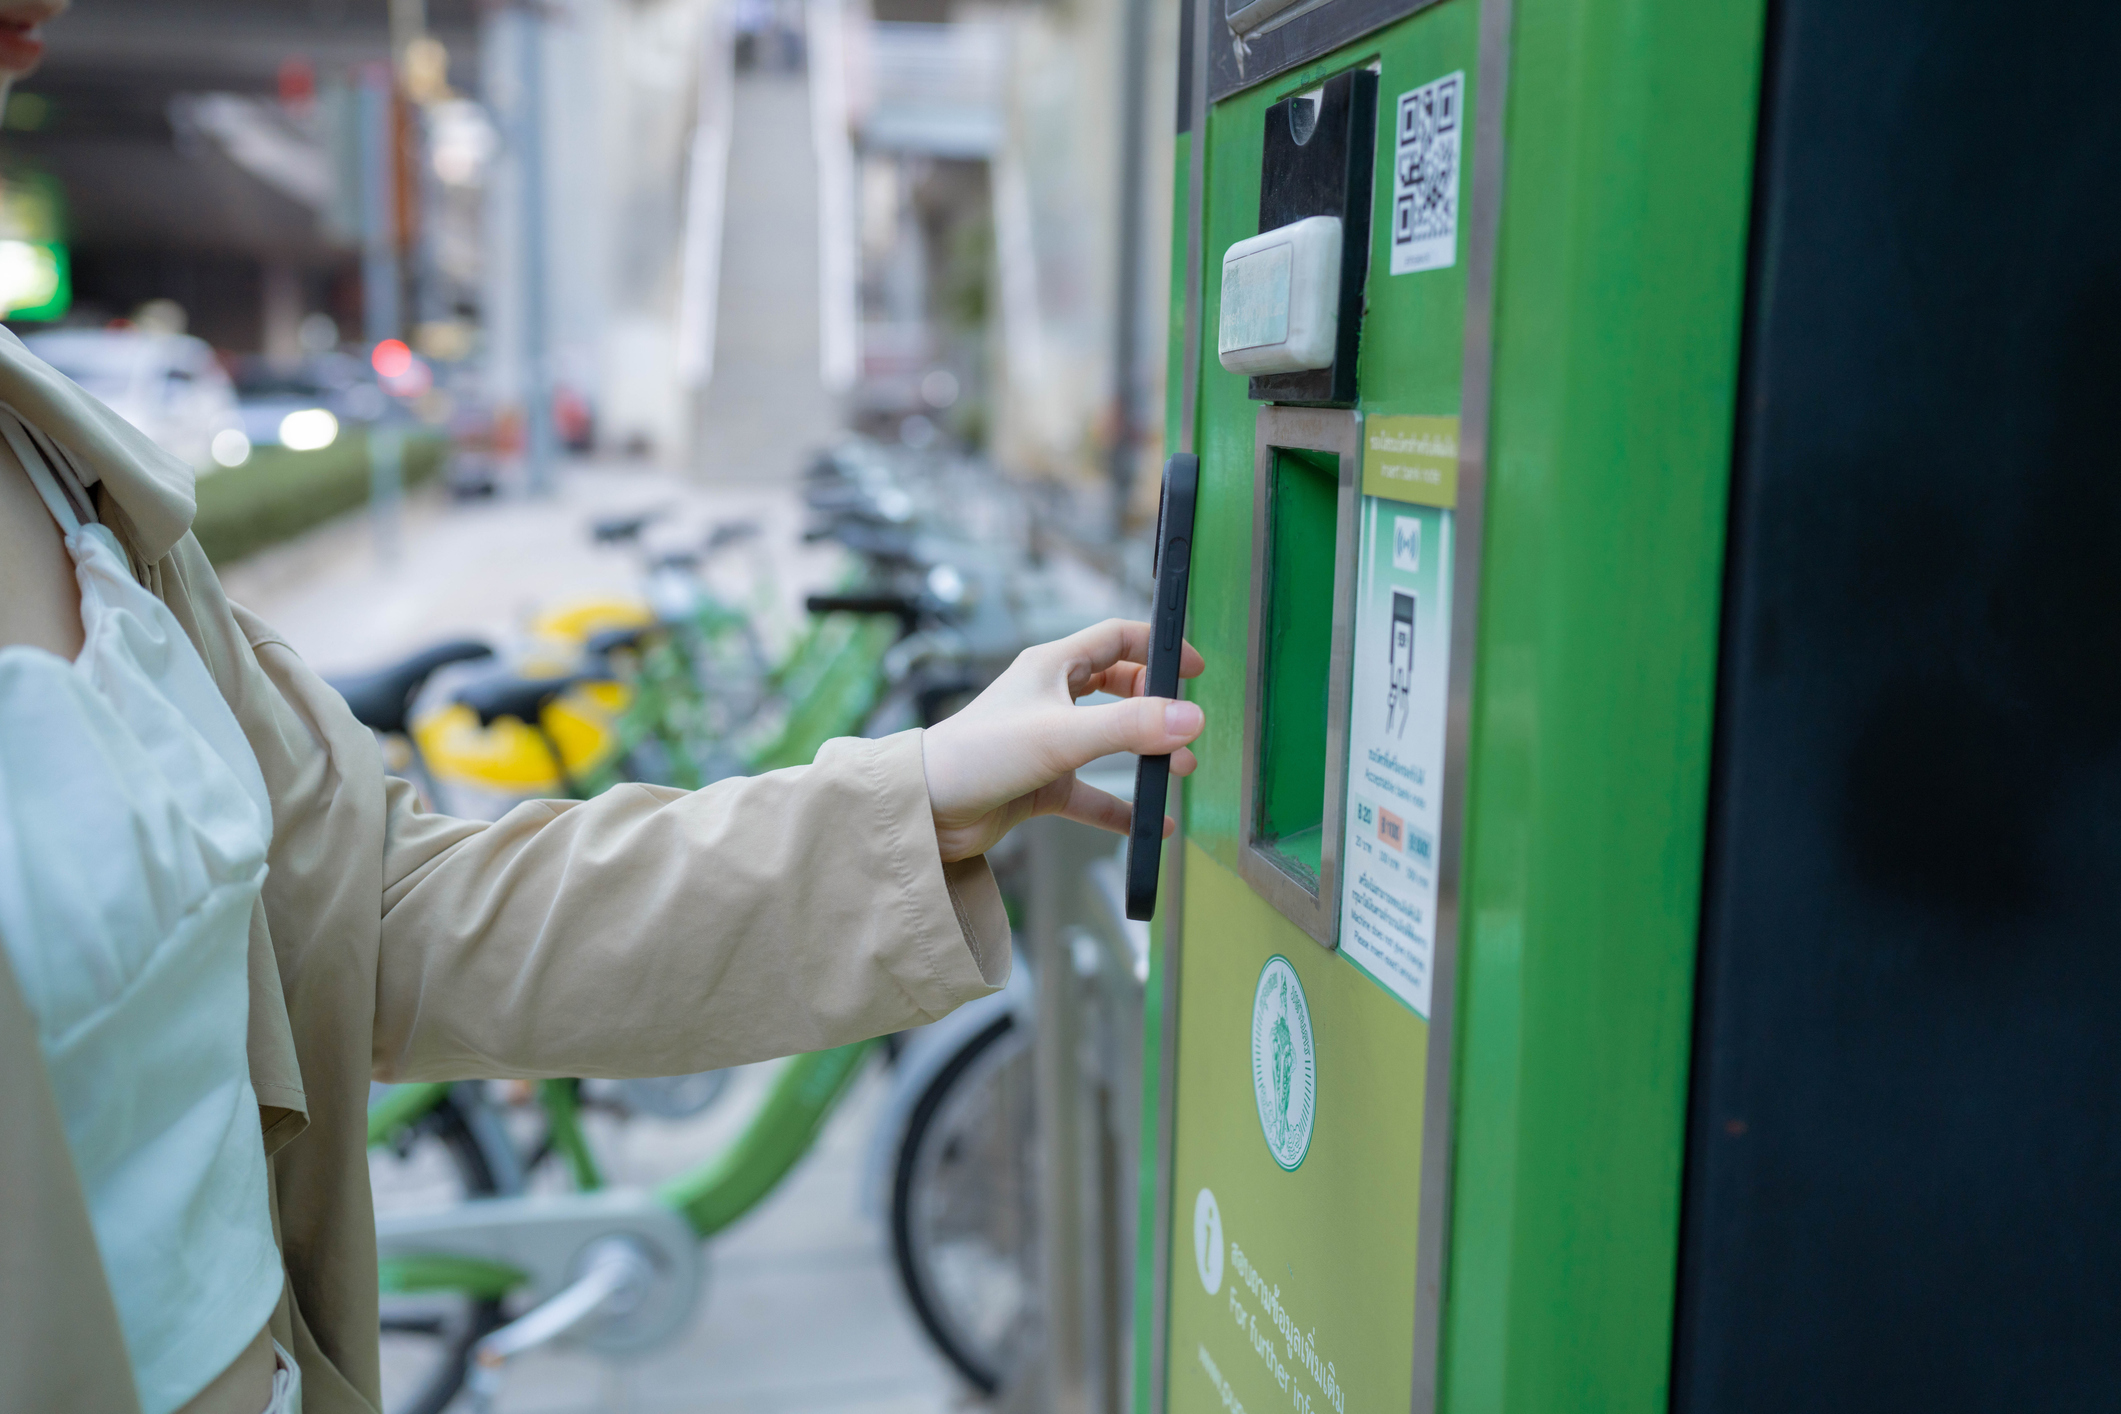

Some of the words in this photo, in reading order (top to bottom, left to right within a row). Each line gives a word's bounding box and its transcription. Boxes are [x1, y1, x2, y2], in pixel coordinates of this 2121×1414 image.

[1229, 1286, 1247, 1331] For
[1250, 1314, 1290, 1393] further
[1293, 1376, 1315, 1414] inf
